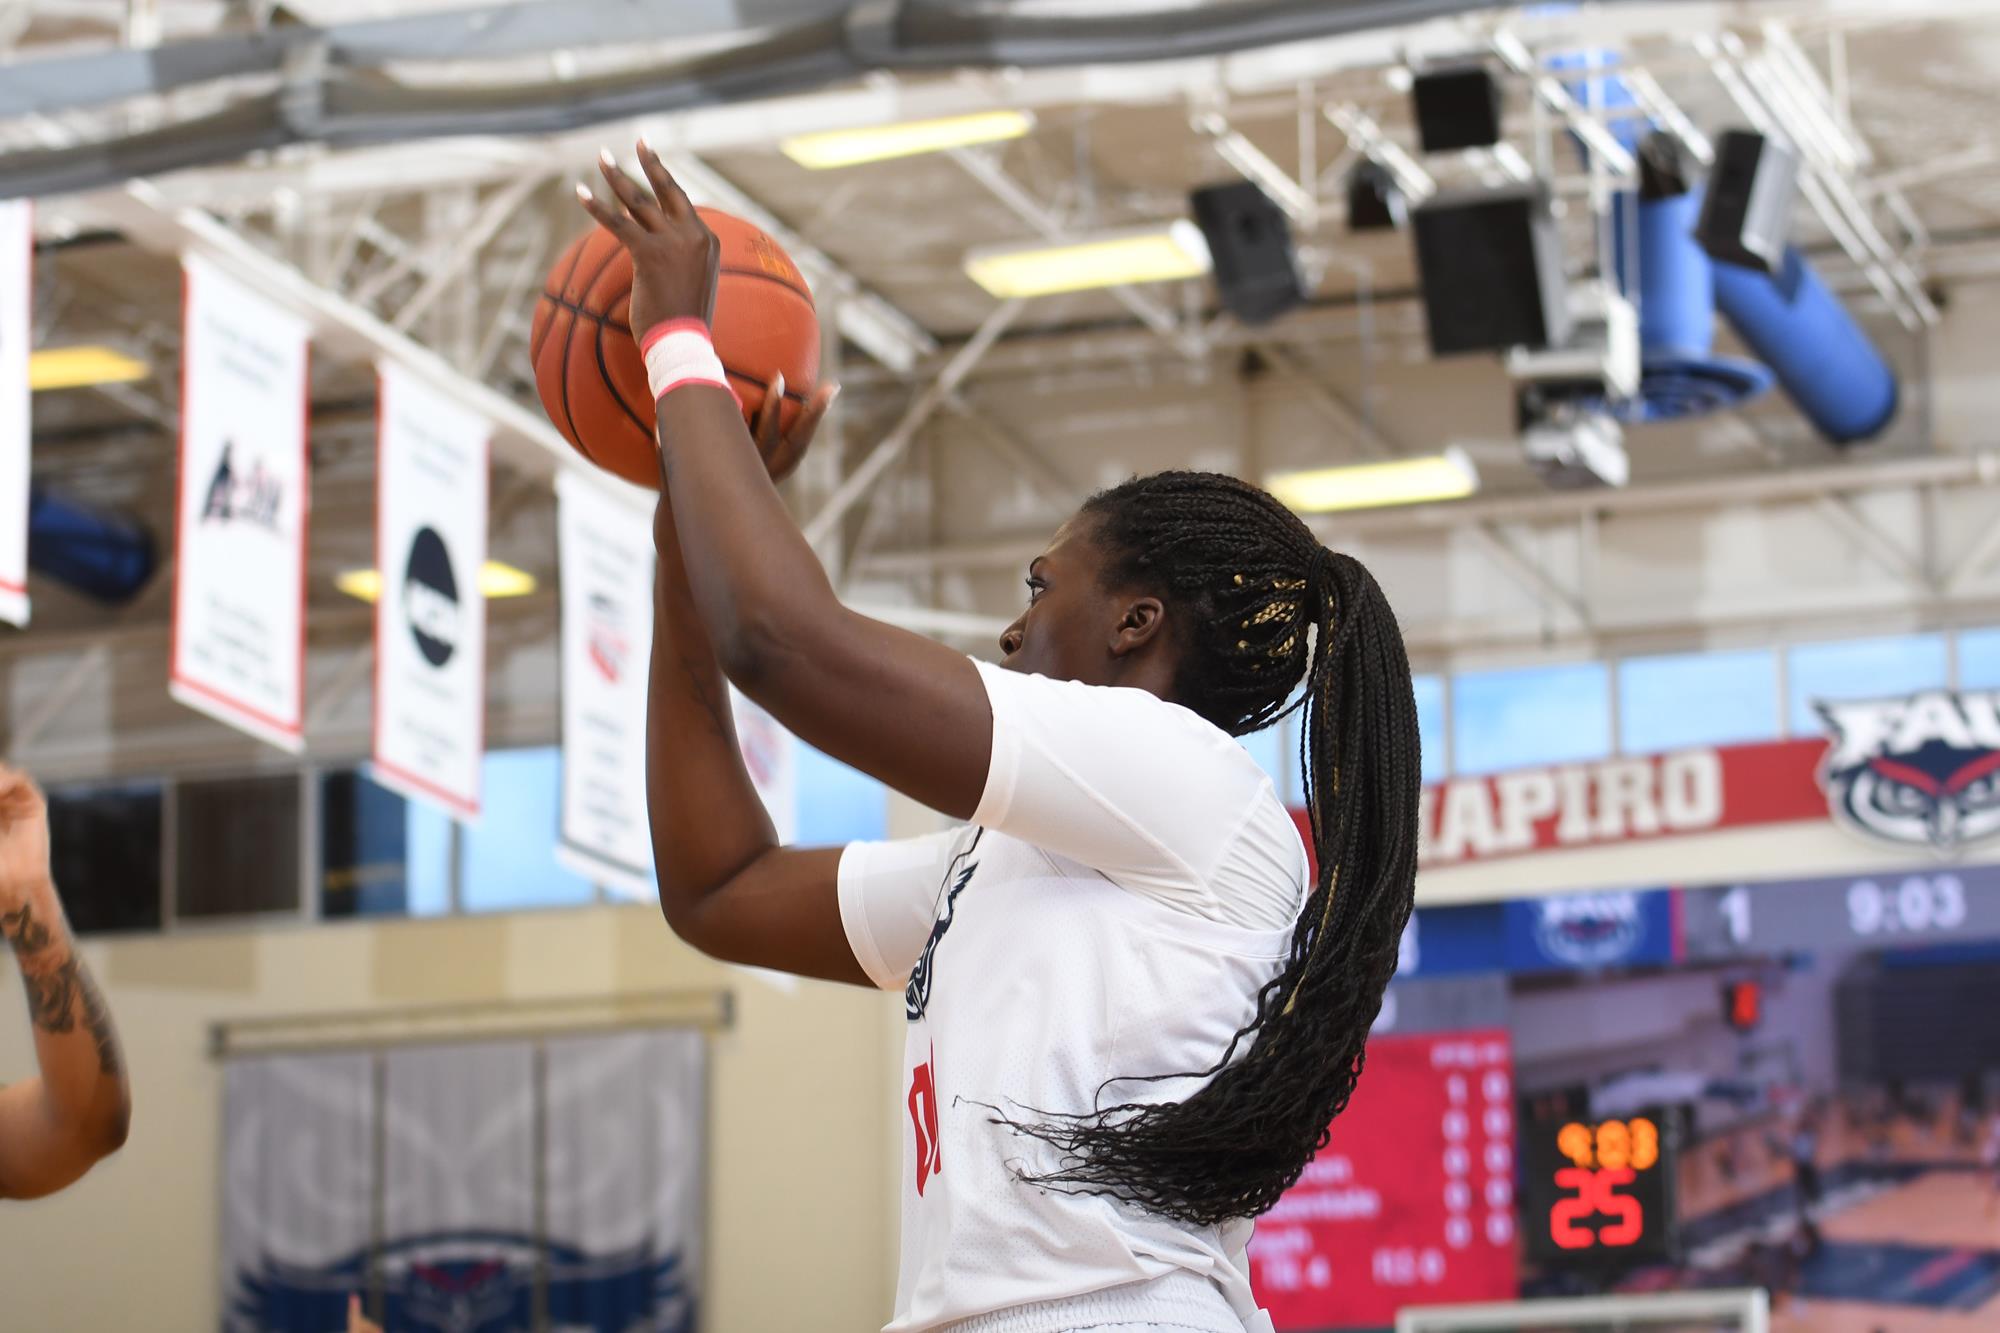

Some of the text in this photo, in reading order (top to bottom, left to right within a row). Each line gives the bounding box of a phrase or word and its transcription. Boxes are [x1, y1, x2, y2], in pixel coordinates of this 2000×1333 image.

[1719, 875, 1967, 943] 1 9:03
[1557, 1117, 1659, 1171] 9:03
[1550, 1167, 1643, 1249] 25
